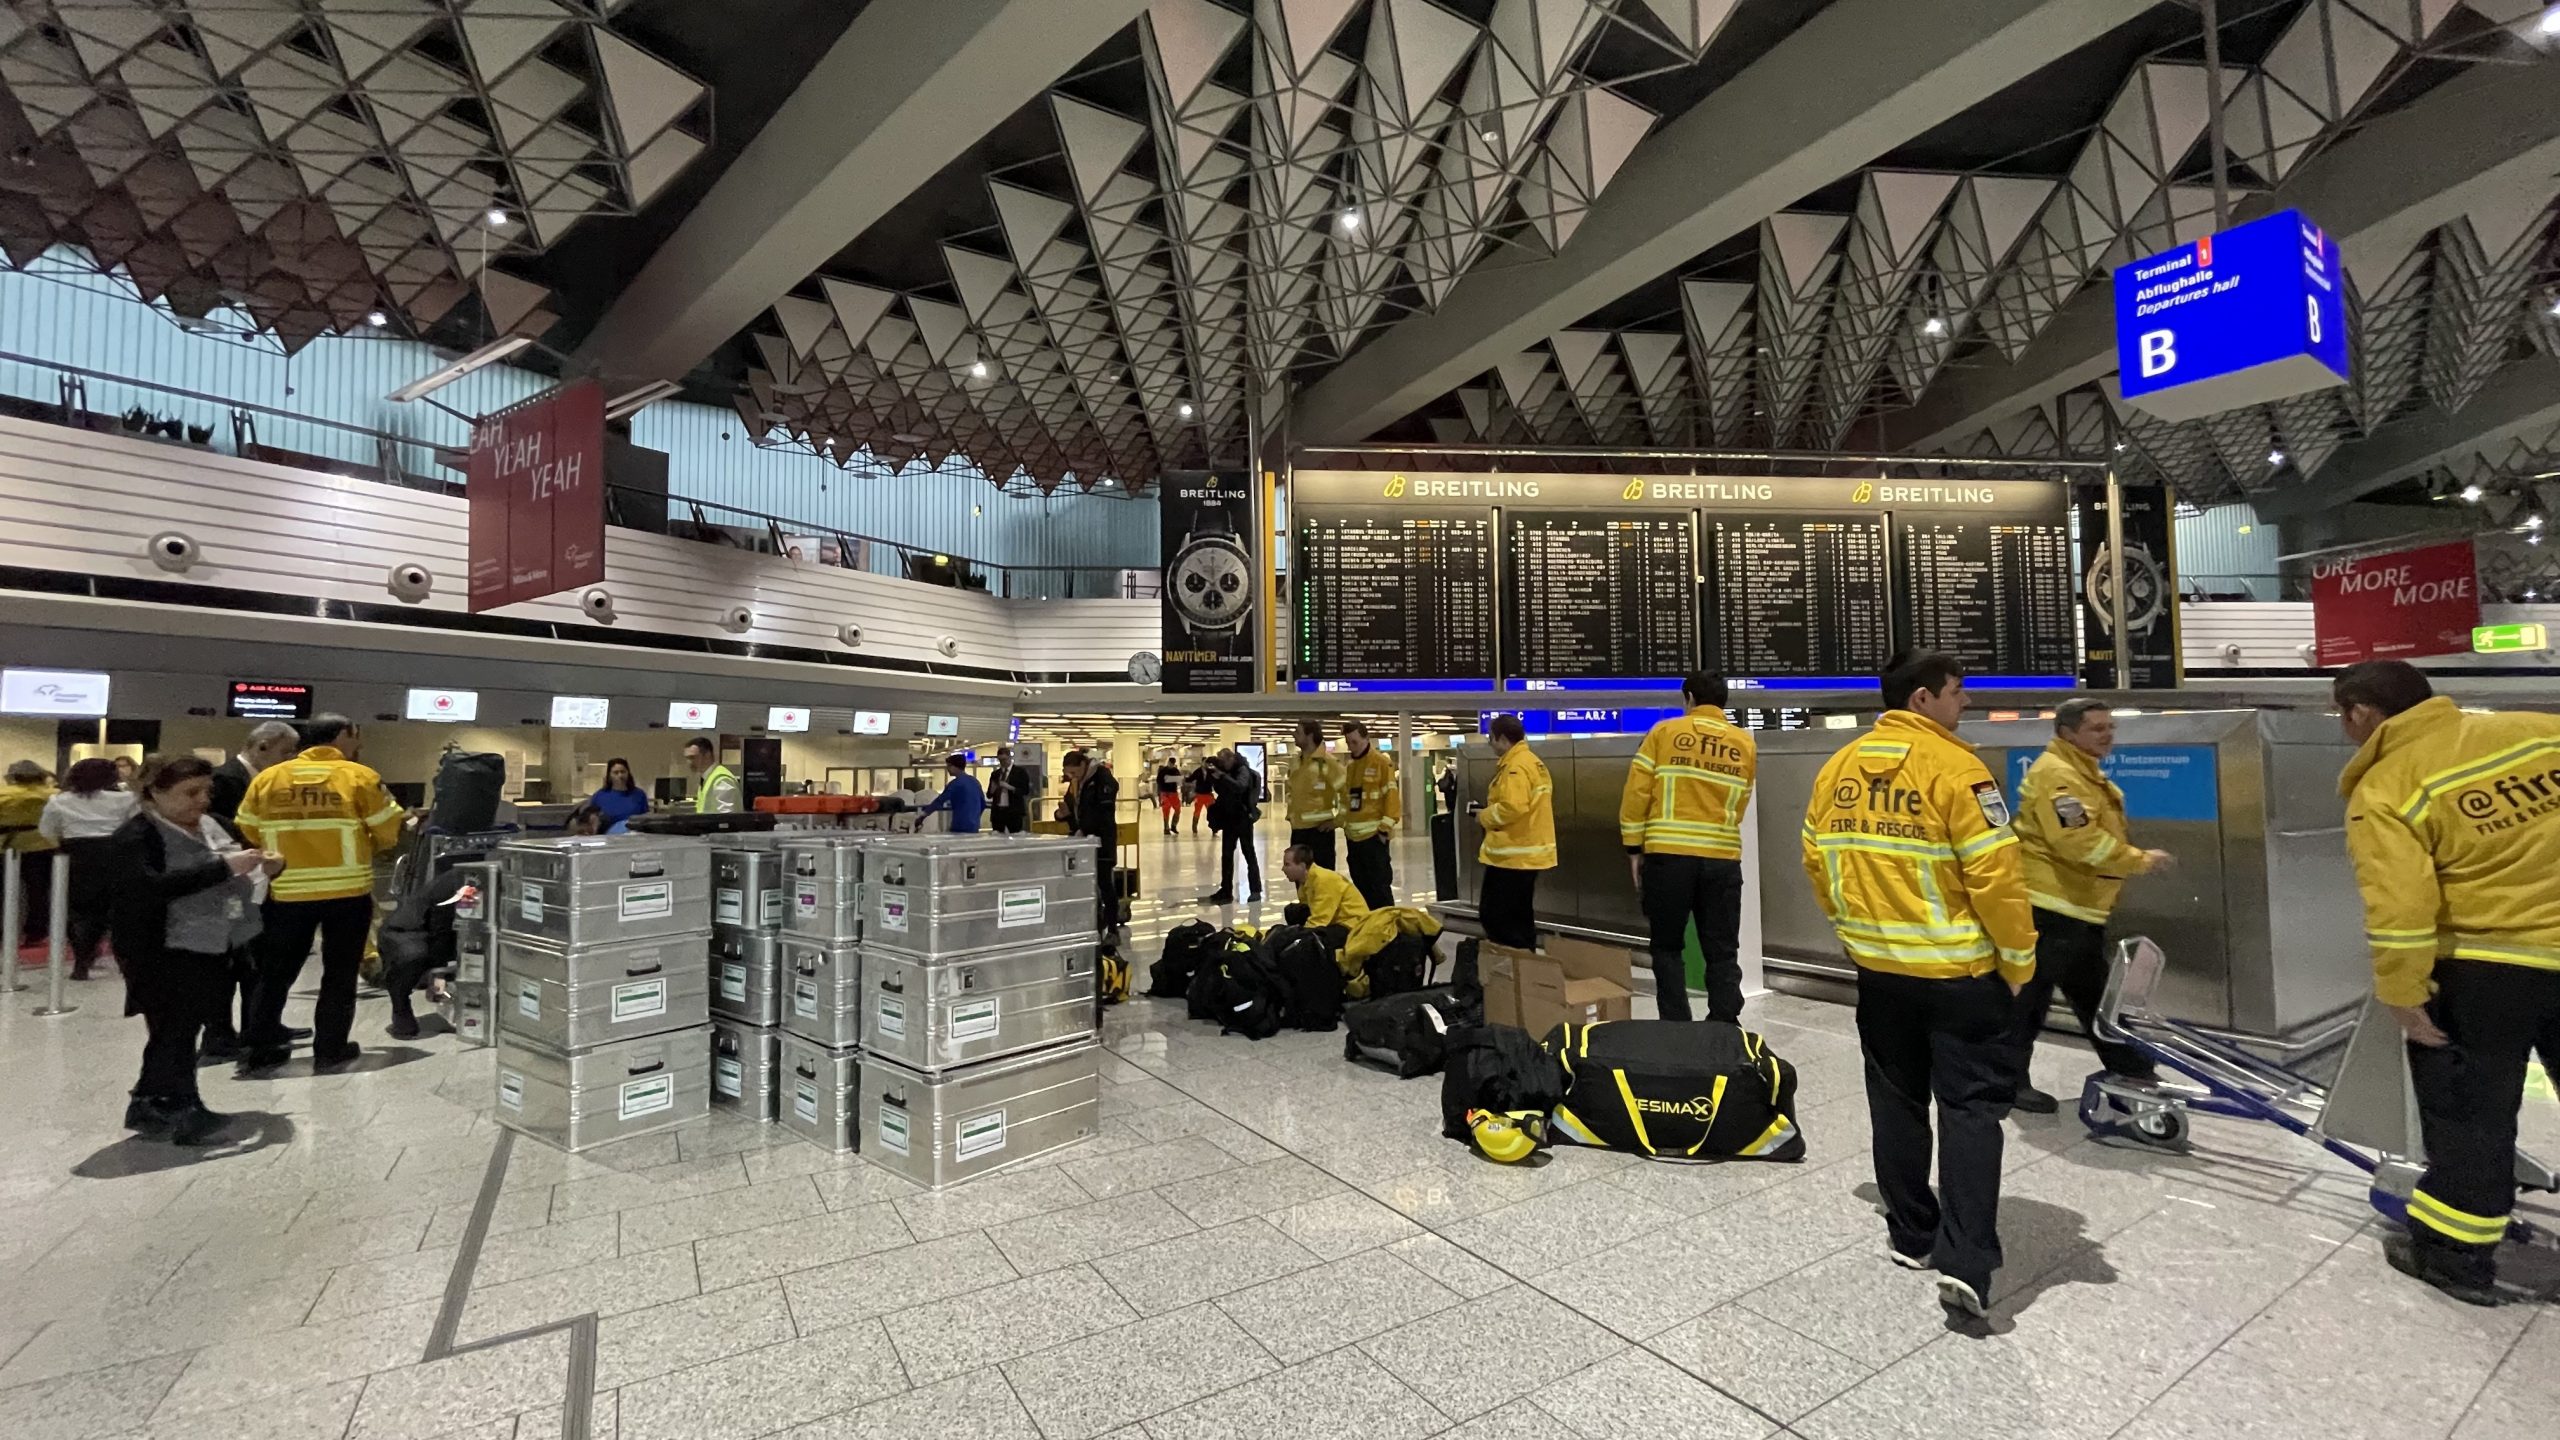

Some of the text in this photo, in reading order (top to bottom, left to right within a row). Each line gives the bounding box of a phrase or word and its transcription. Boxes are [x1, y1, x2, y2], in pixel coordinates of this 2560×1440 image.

[2134, 248, 2208, 282] Terminal 1
[2136, 270, 2214, 302] Abflughalle
[2136, 275, 2240, 318] Departures hall
[2307, 294, 2321, 343] B
[2140, 328, 2176, 378] B
[531, 451, 582, 502] YEAH
[1180, 489, 1246, 499] BREITLING
[1413, 480, 1540, 498] BREITLING
[1652, 483, 1773, 500] BREITLING
[1879, 486, 1995, 504] BREITLING
[2093, 502, 2151, 511] BRLING
[2339, 564, 2414, 595] MORE
[2393, 576, 2472, 606] MORE
[1165, 650, 1217, 662] NAVITIMER
[1517, 711, 1524, 721] C
[1670, 756, 1692, 767] FIRE
[1704, 761, 1741, 777] RESCUE
[1830, 818, 1929, 841] FIRE & RESCUE
[2475, 815, 2514, 837] FIRE
[1634, 1098, 1712, 1121] ESIMAX
